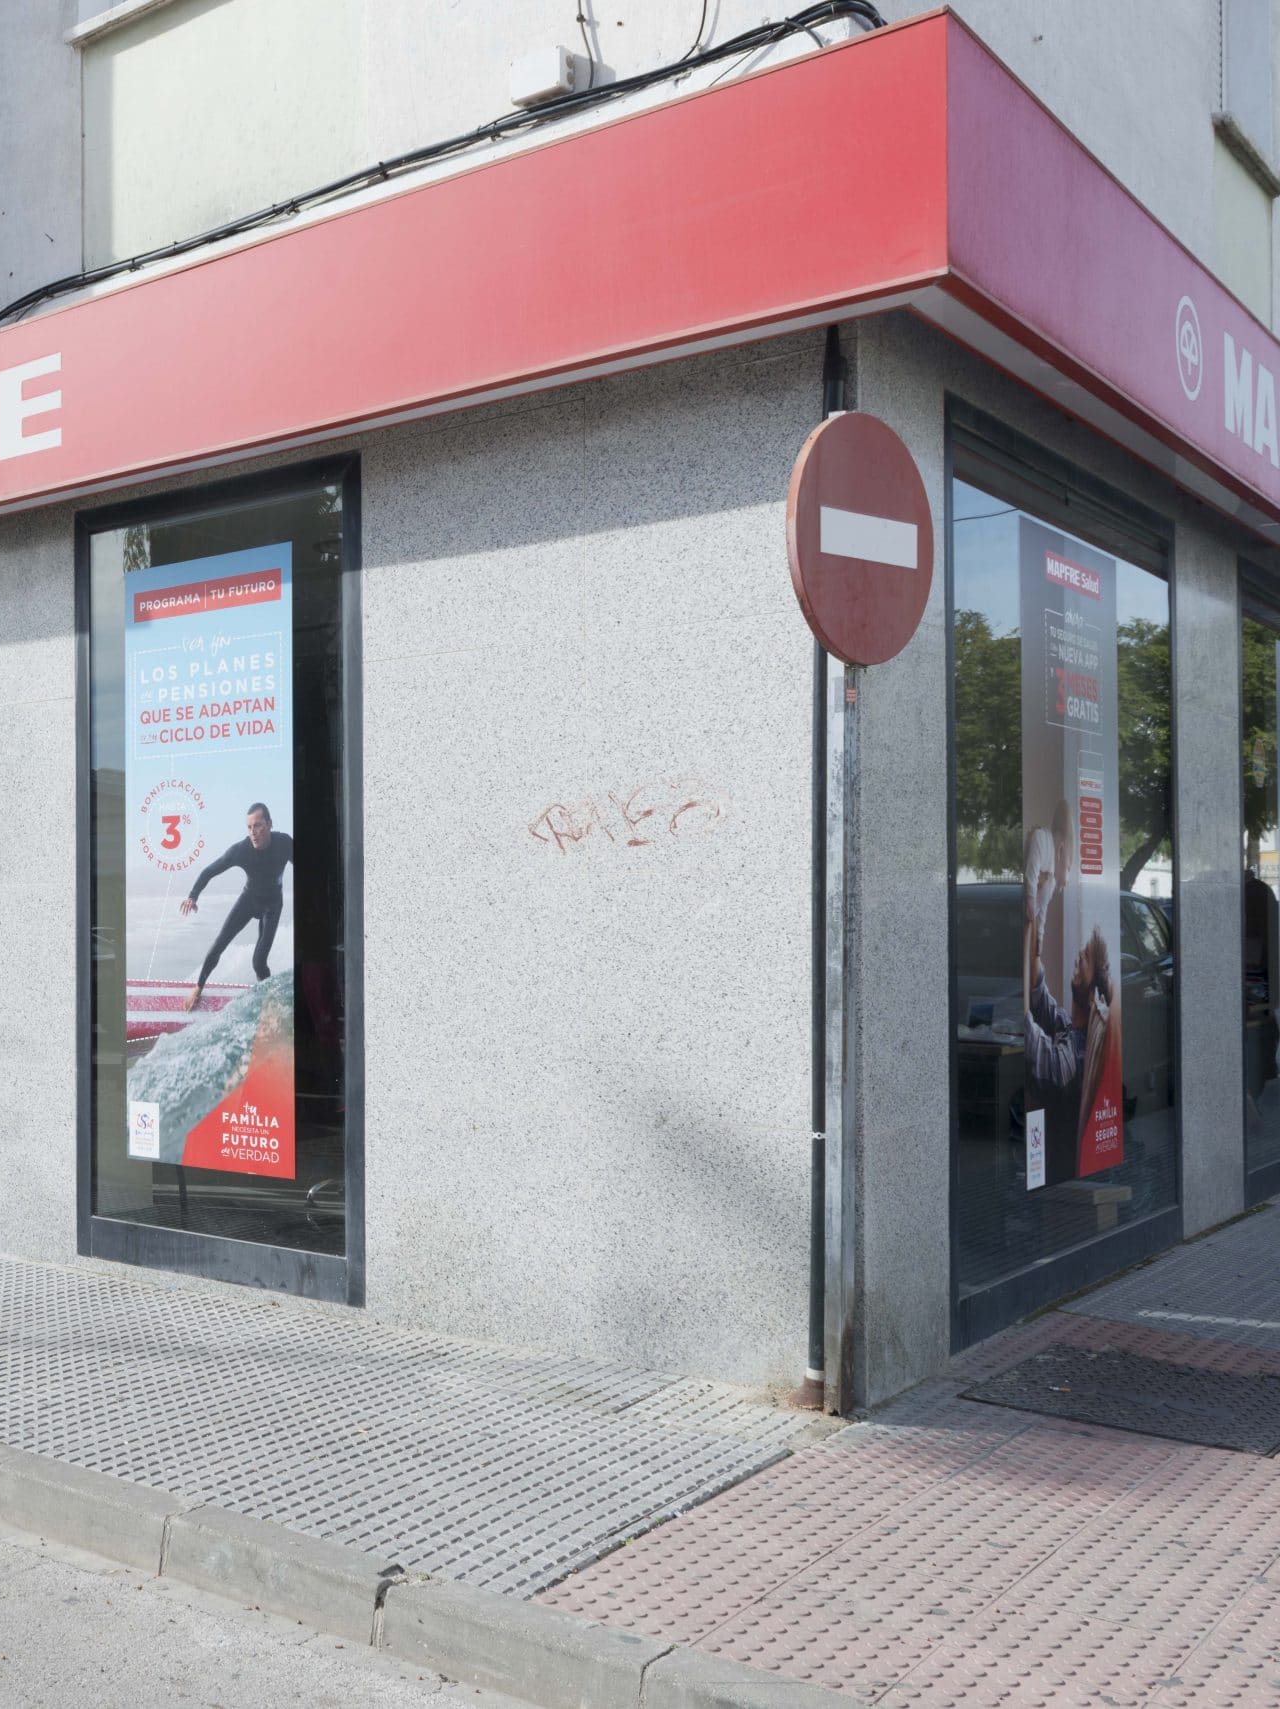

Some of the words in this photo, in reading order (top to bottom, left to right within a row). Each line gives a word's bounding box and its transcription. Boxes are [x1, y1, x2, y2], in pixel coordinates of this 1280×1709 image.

[1224, 328, 1280, 470] MA
[1047, 557, 1080, 587] MAPFRE
[1081, 572, 1099, 594] Salud
[140, 593, 200, 612] PROGRAMA
[210, 588, 224, 600] TU
[229, 580, 275, 597] FUTURO
[1059, 643, 1083, 665] NUEVA
[141, 665, 177, 684] LOS
[190, 652, 275, 678] PLANES
[159, 675, 275, 702] PENSIONES
[140, 708, 171, 725] QUE
[176, 705, 194, 721] SE
[199, 697, 275, 719] ADAPTAN
[1067, 695, 1099, 723] GRATIS
[160, 726, 205, 744] CICLO
[210, 723, 230, 739] DE
[236, 719, 275, 736] VIDA
[139, 837, 154, 861] POR
[222, 1112, 279, 1128] FAMILIA
[243, 1101, 257, 1115] tu
[222, 1133, 279, 1149] FUTURO
[1095, 1126, 1118, 1142] SEGURO
[231, 1147, 280, 1163] VERDAD
